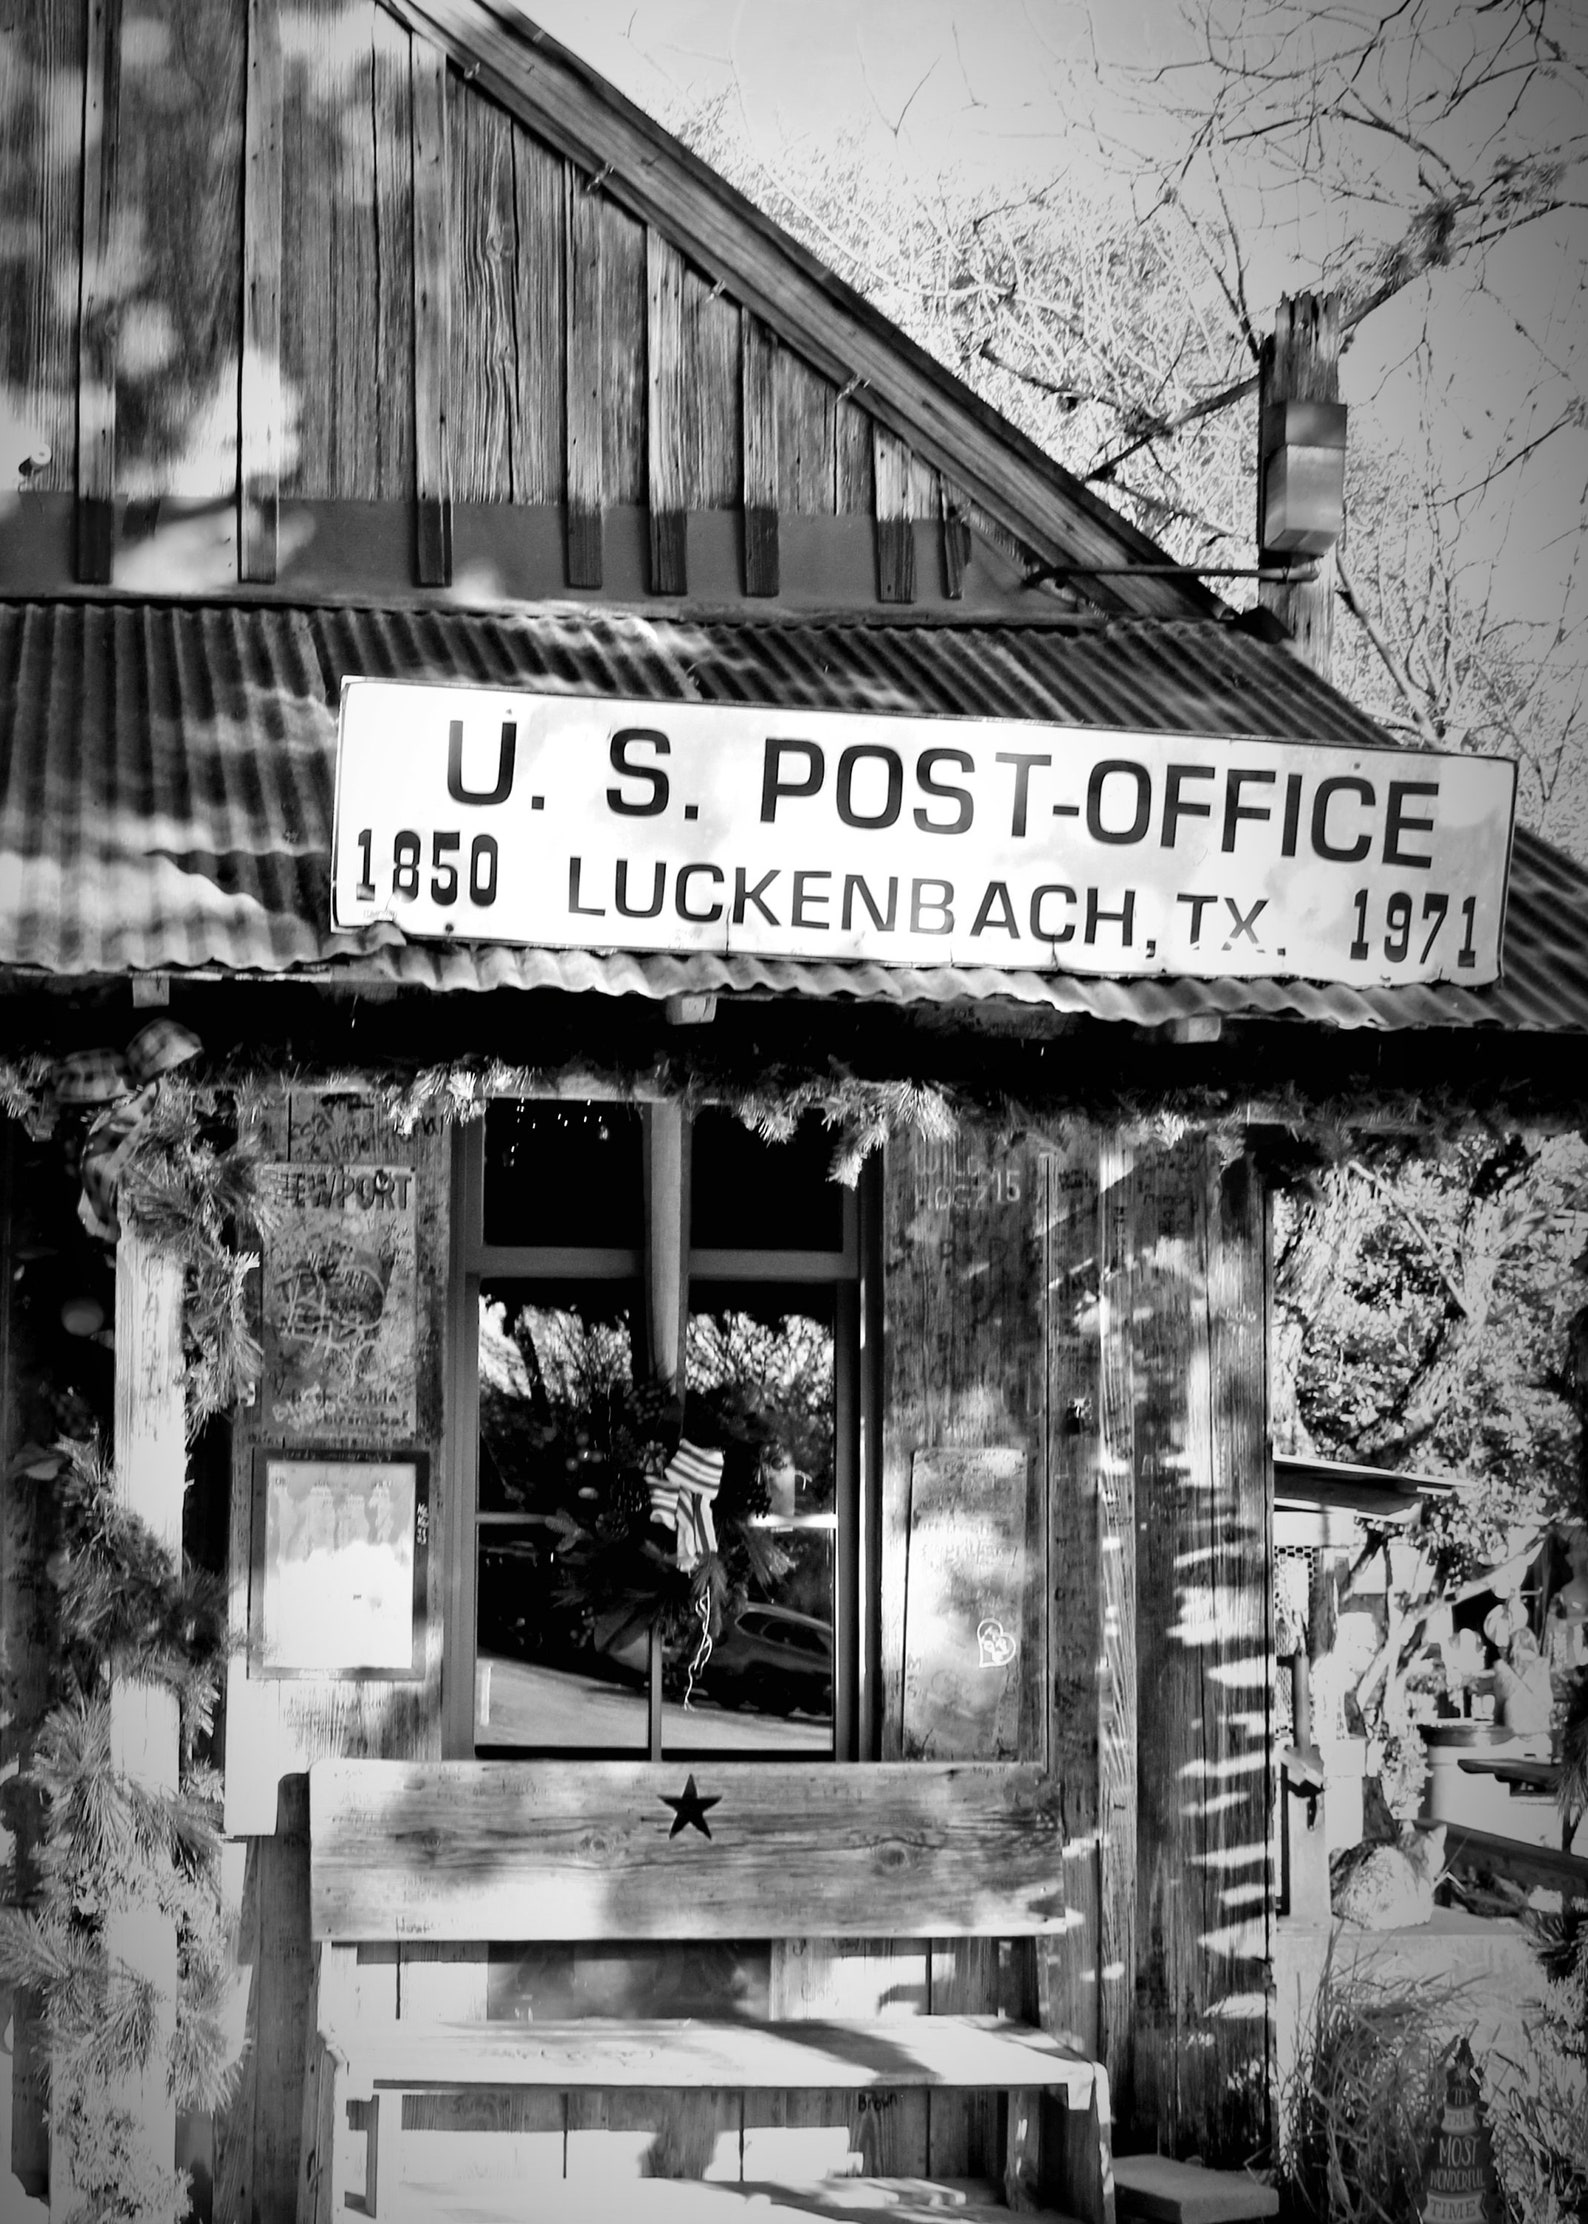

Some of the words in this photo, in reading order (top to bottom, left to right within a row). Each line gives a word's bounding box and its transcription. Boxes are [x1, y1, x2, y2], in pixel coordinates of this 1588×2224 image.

[446, 719, 546, 811] U.
[605, 726, 700, 822] S.
[759, 736, 1440, 868] POST-OFFICE
[355, 828, 499, 909] 1850
[568, 855, 1158, 960] LUCKENBACH,
[1176, 891, 1287, 958] TX.
[1349, 888, 1477, 969] 1971
[1447, 2110, 1472, 2126] THE
[1439, 2135, 1481, 2168] MOST
[1429, 2167, 1486, 2192] WONDERFUL
[1431, 2200, 1476, 2220] TIME
